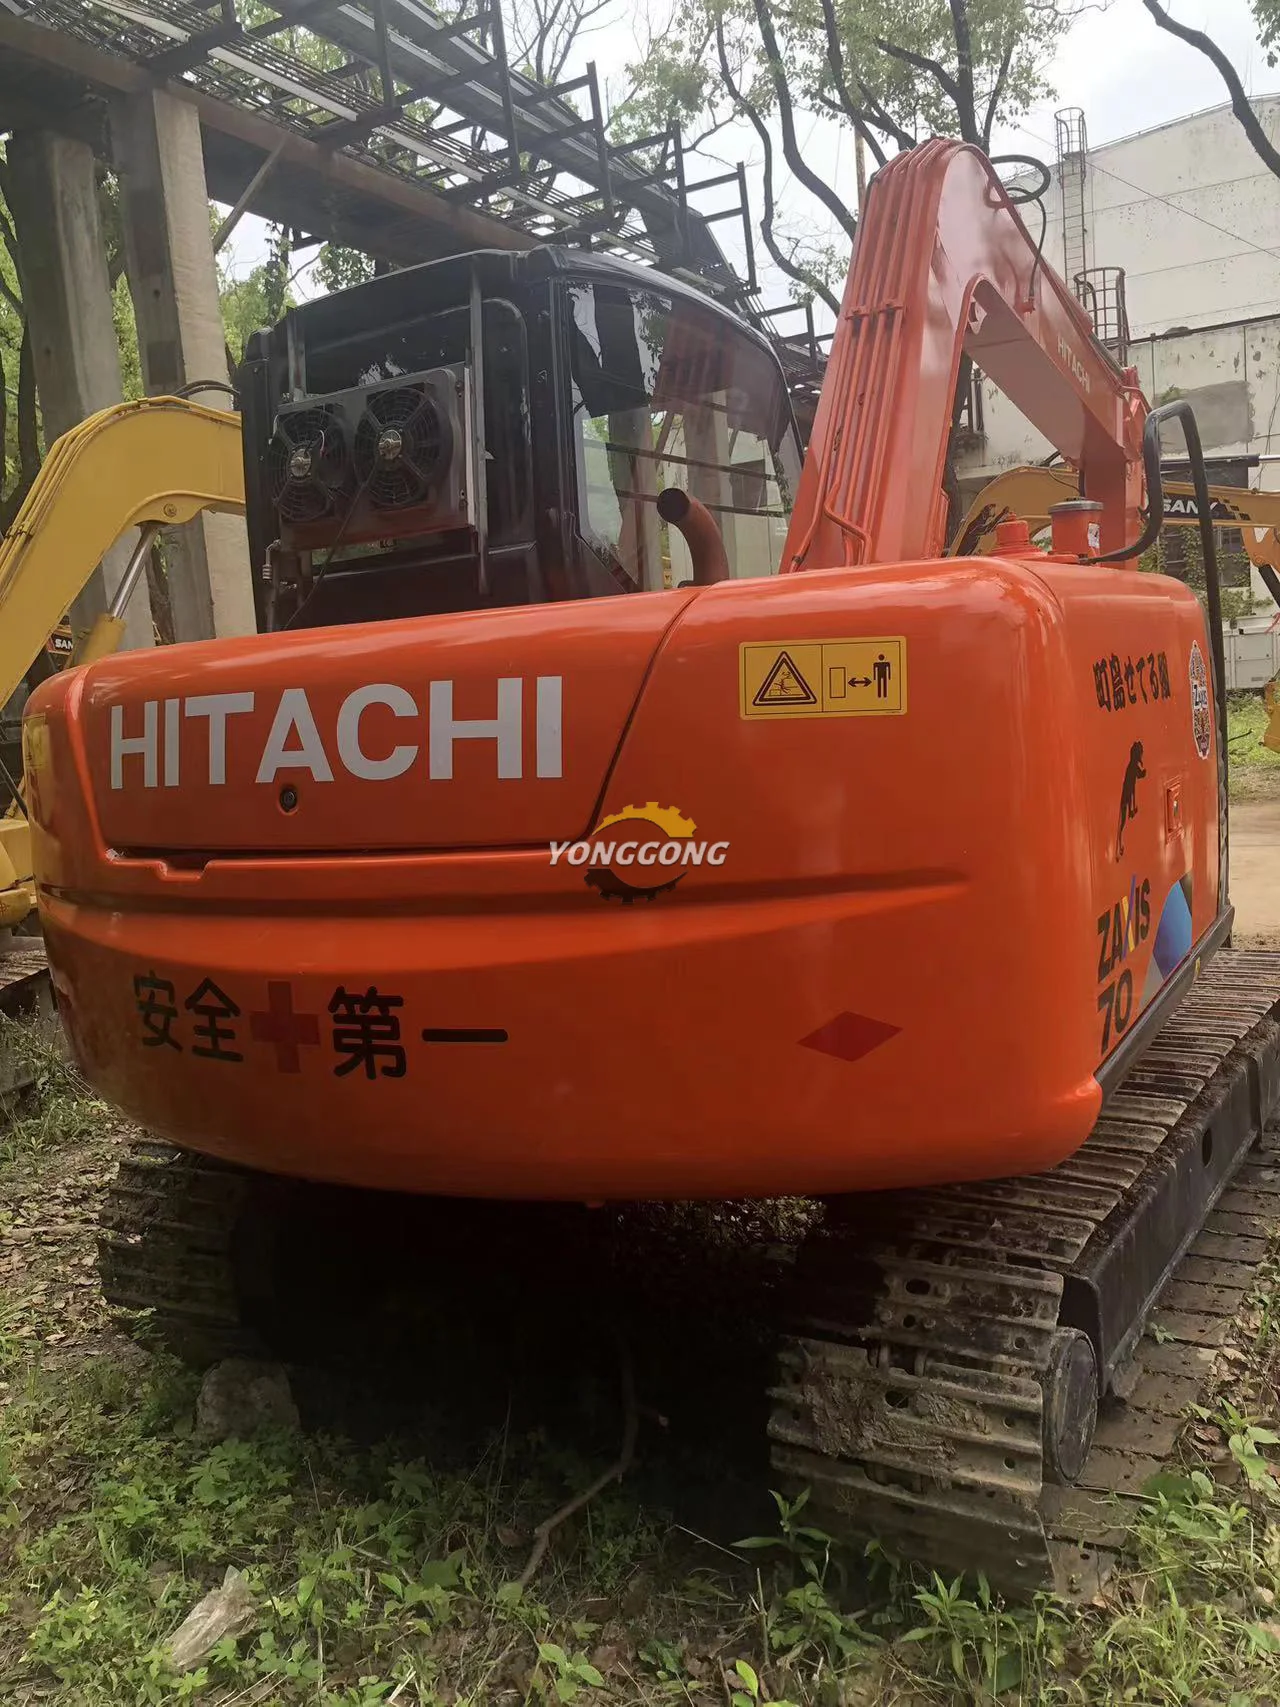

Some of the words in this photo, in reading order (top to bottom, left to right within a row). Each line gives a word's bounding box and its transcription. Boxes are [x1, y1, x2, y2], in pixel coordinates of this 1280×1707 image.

[1057, 335, 1090, 393] HITACHI
[1163, 499, 1218, 514] SAN
[110, 676, 562, 789] HITACHI
[1097, 874, 1151, 984] ZAXIS
[134, 970, 244, 1063] 安全
[328, 986, 508, 1080] 第一
[1097, 968, 1133, 1055] 70
